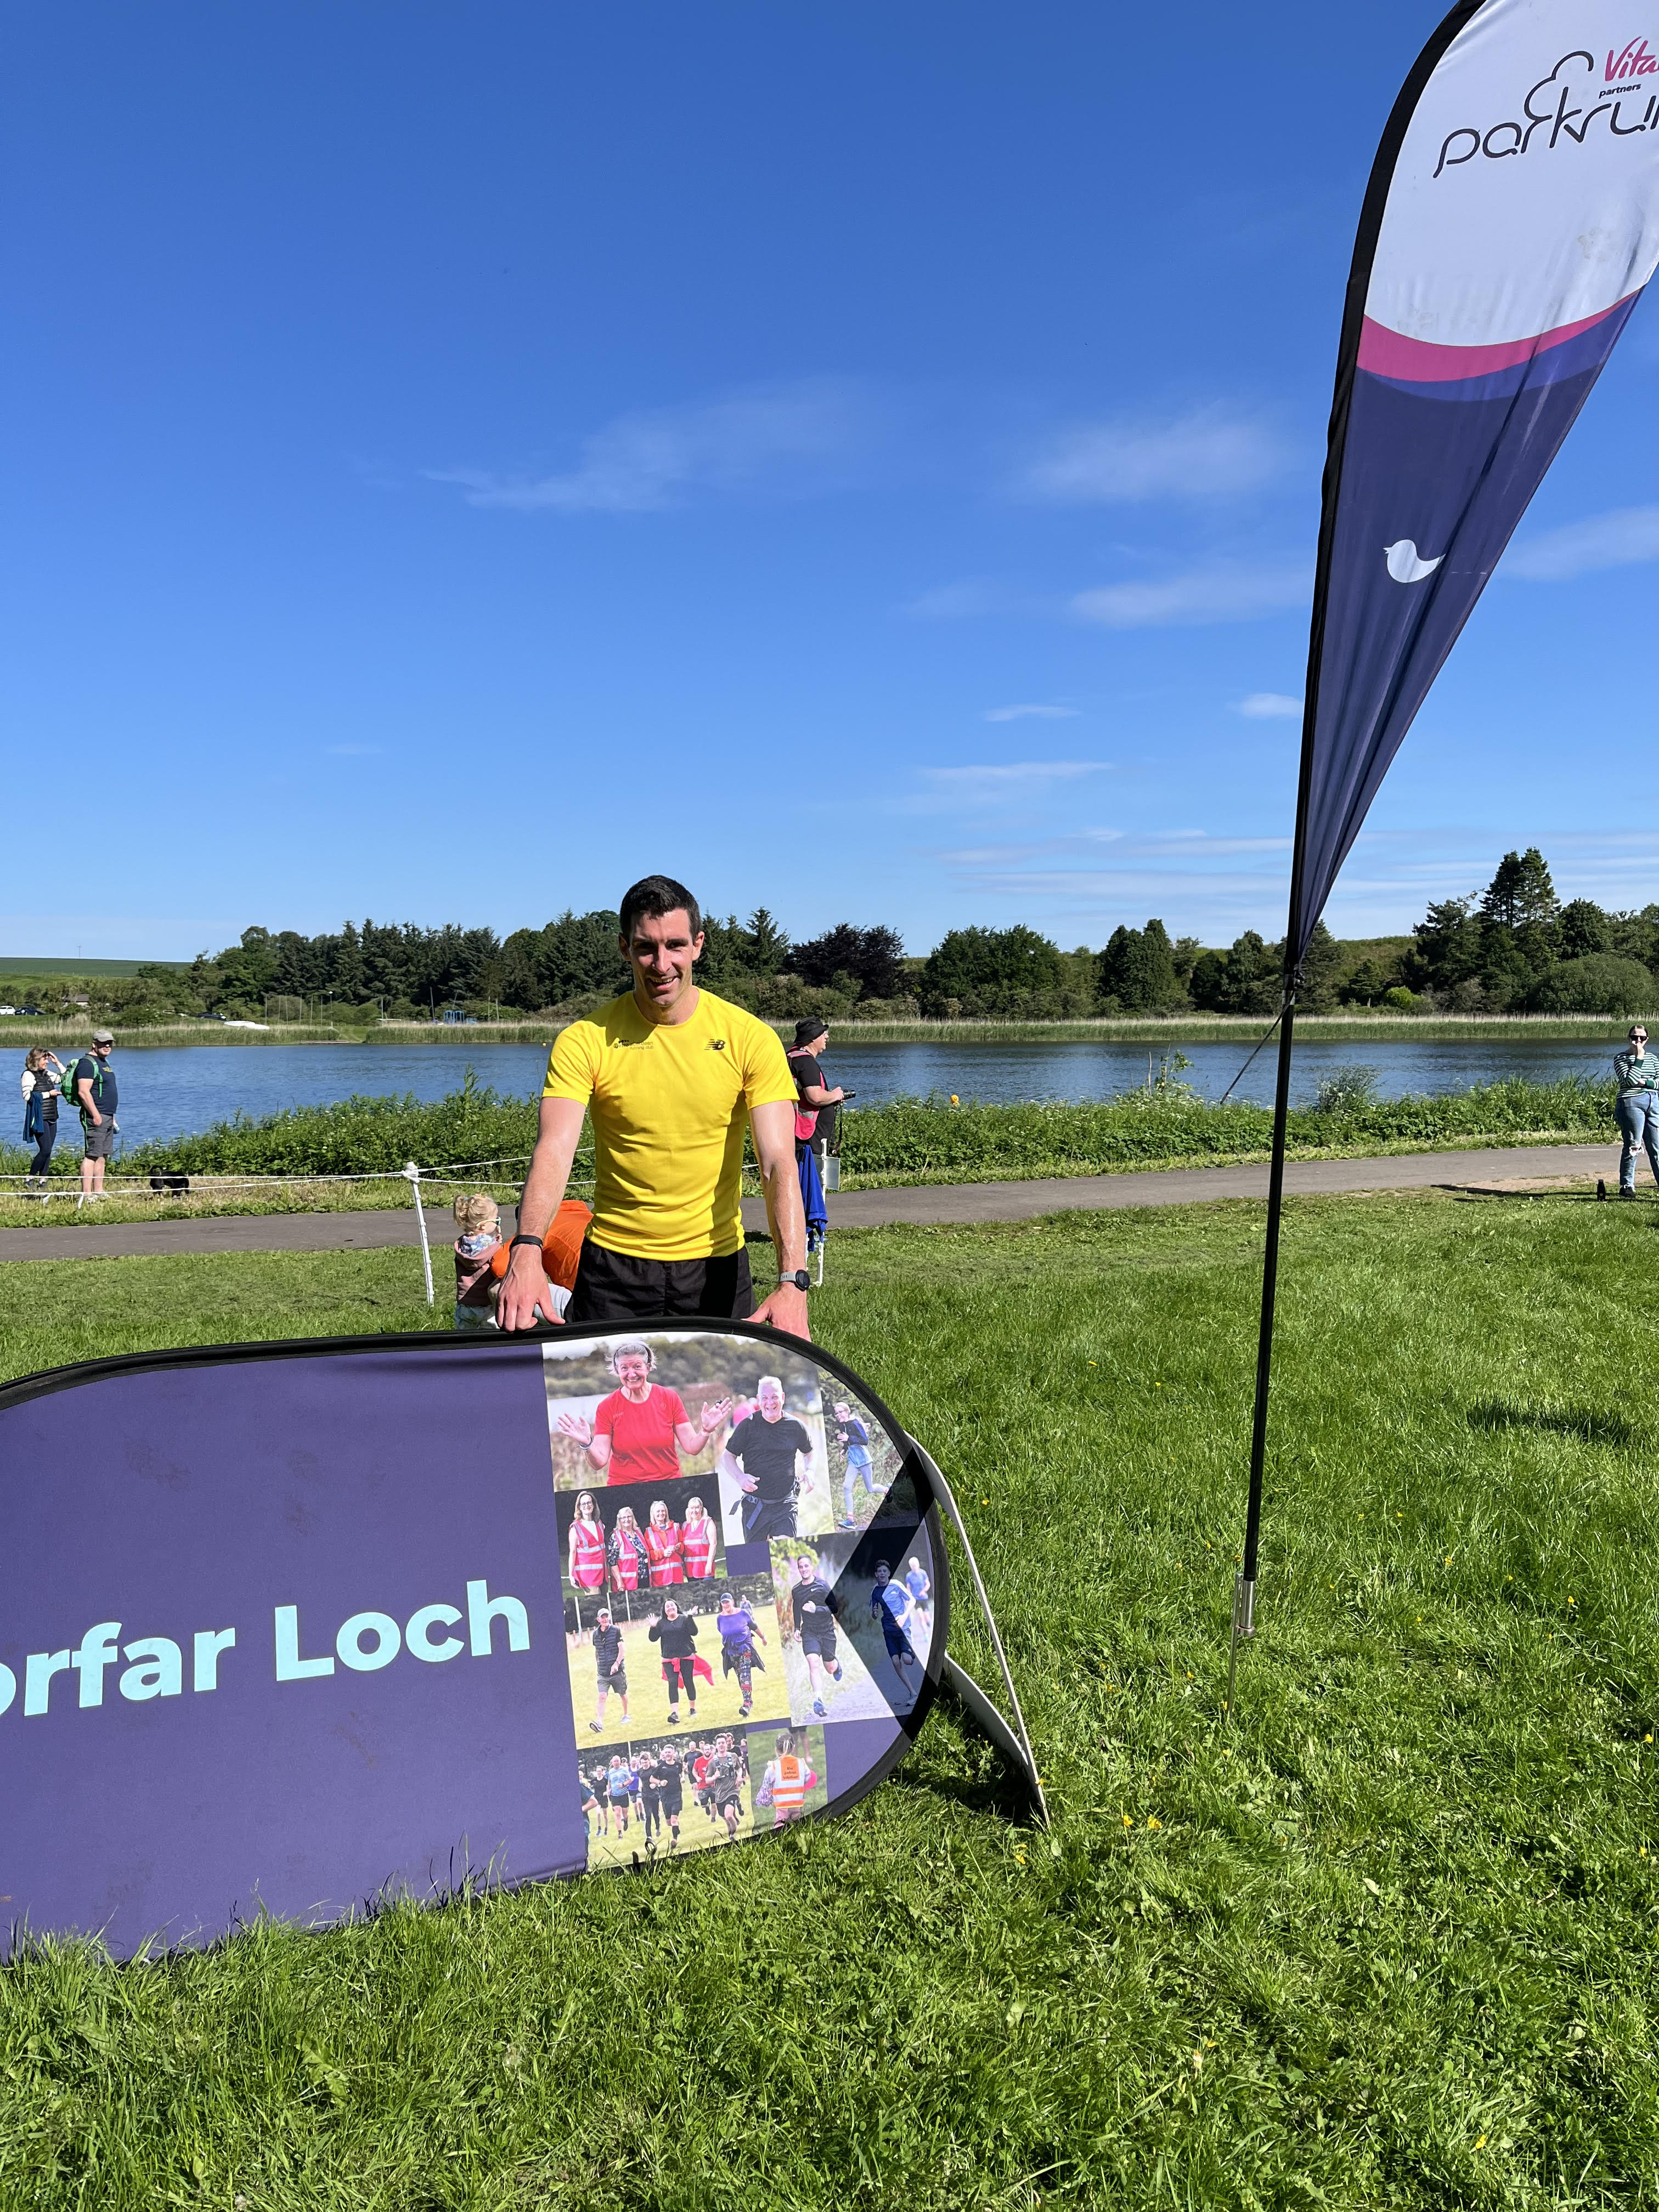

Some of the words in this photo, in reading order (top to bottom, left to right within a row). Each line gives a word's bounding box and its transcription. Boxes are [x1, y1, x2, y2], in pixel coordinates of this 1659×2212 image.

[1605, 36, 1659, 82] Vita
[1599, 84, 1641, 99] partners
[0, 1622, 235, 1716] rfar
[275, 1579, 530, 1681] Loch
